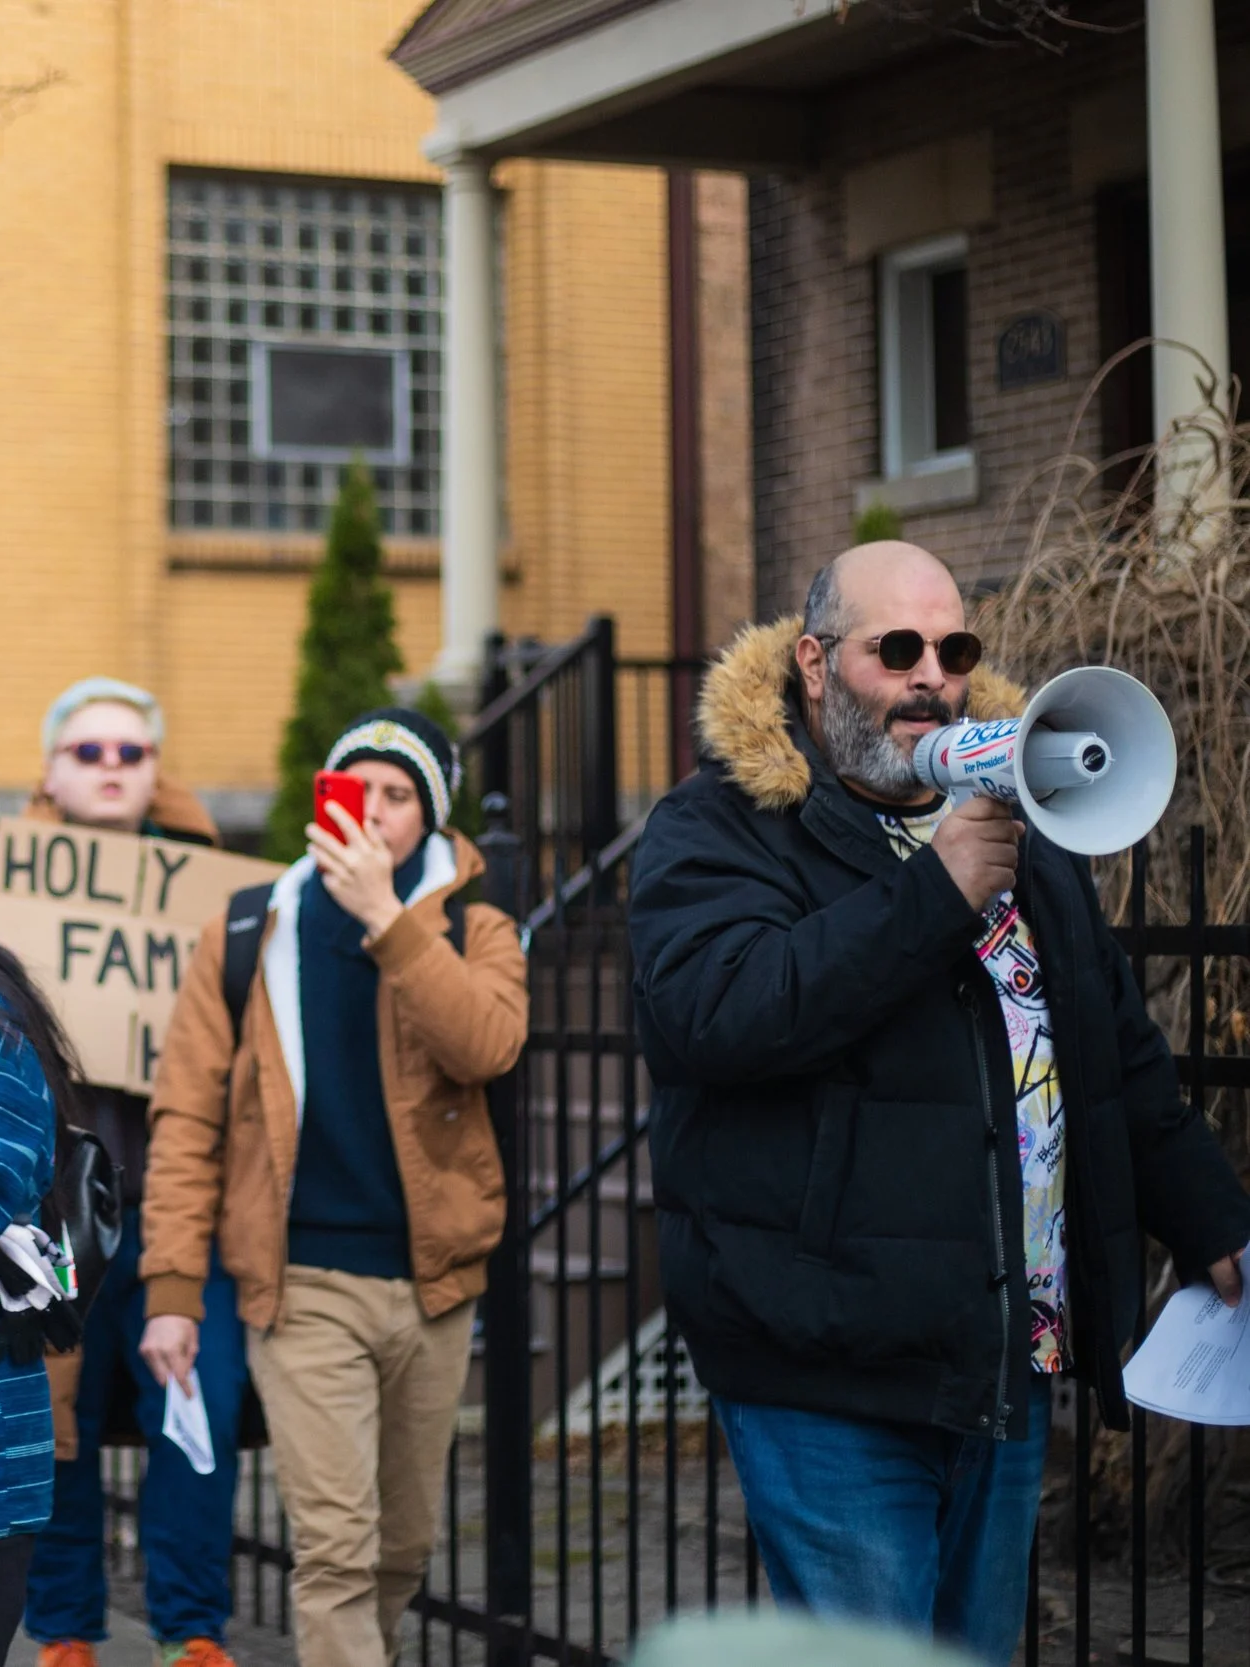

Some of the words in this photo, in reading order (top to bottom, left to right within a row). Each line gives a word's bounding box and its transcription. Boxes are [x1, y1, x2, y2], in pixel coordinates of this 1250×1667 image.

[963, 763, 976, 775] For
[975, 752, 1007, 771] President
[3, 832, 191, 912] HOLY
[60, 918, 200, 993] FAM
